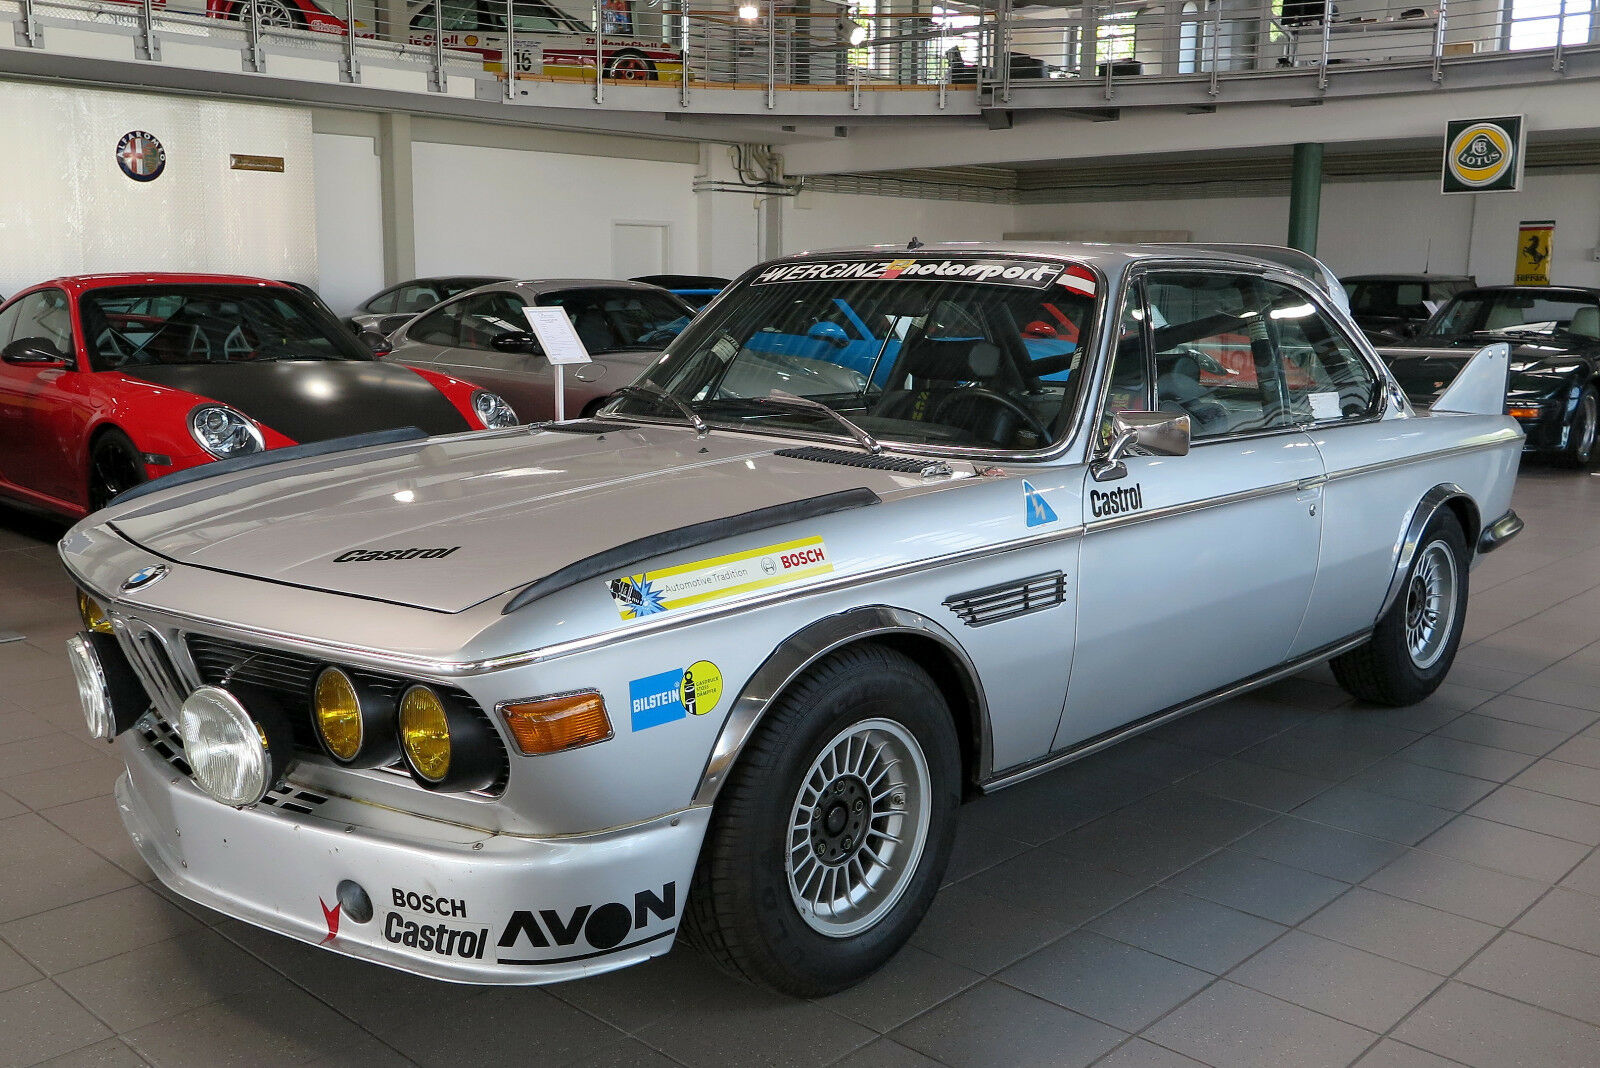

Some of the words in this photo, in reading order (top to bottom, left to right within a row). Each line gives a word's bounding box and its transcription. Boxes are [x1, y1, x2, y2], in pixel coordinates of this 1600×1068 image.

[513, 49, 532, 72] 16
[1460, 152, 1500, 165] LOTUS
[761, 262, 887, 283] WERGINZ
[1090, 483, 1143, 518] Castrol
[333, 546, 461, 562] Castrol
[665, 577, 712, 594] Automotive
[713, 567, 748, 584] Tradition
[780, 548, 825, 569] BOSCH
[633, 689, 681, 713] BILSTEIN
[392, 887, 467, 918] BOSCH
[497, 881, 676, 949] AVON
[385, 912, 488, 959] Castrol
